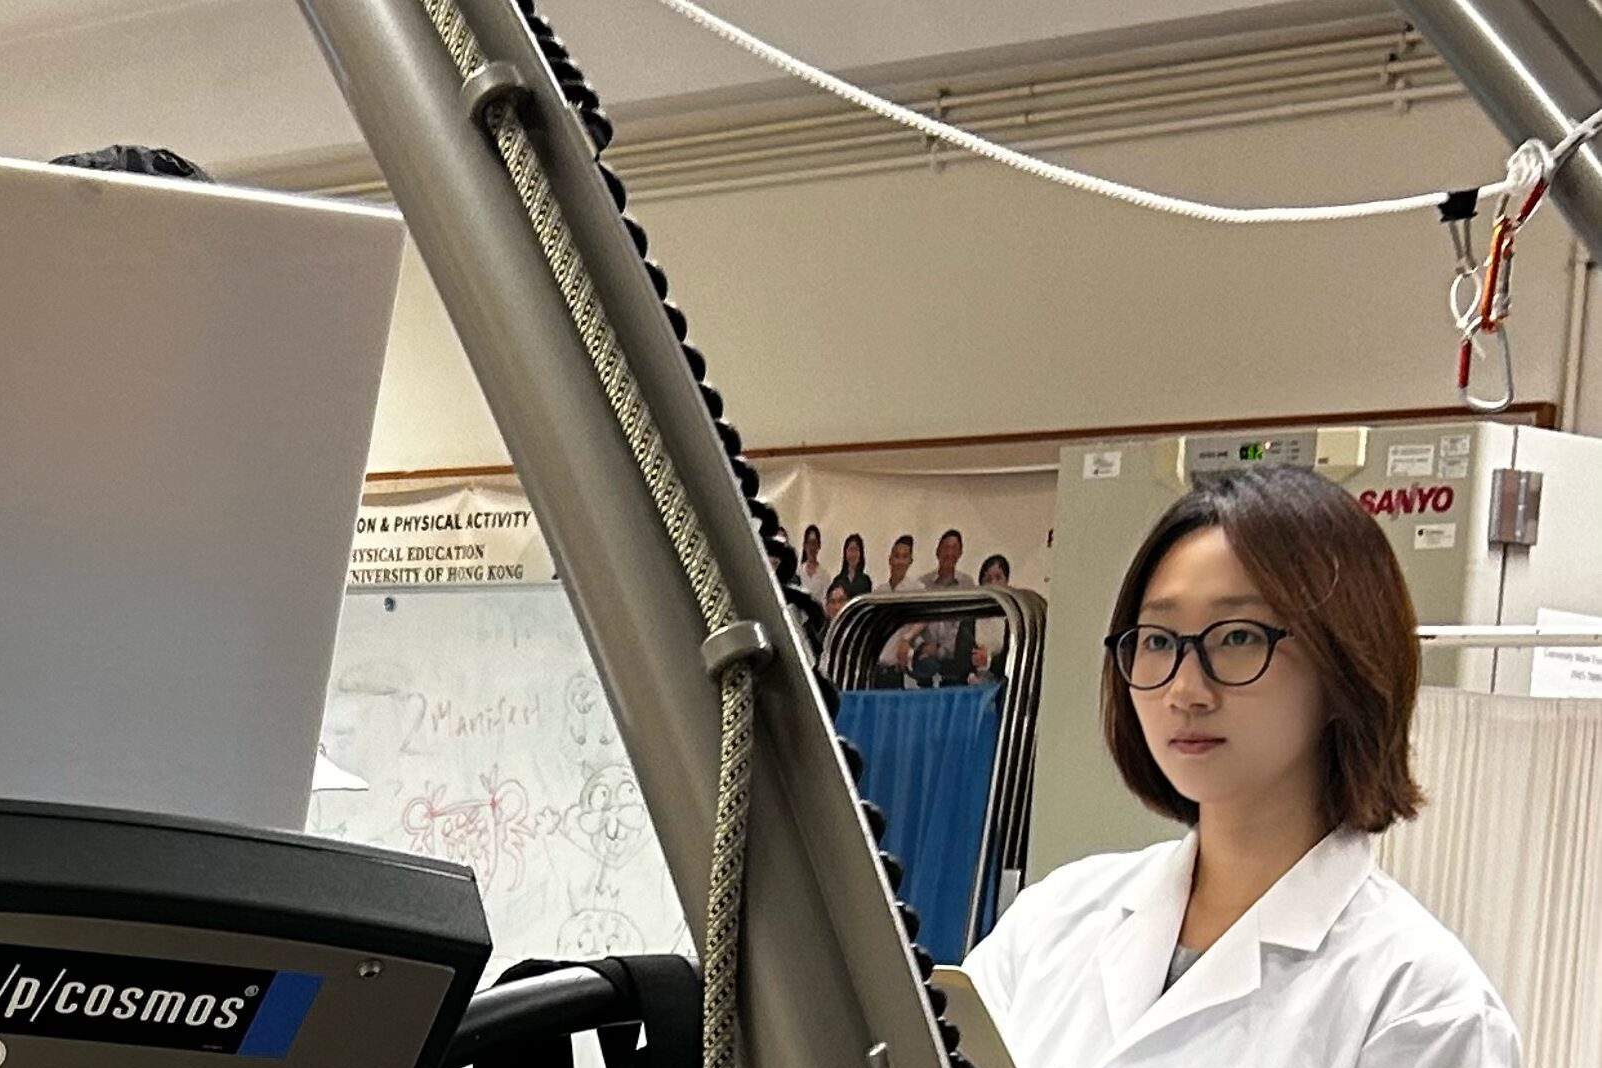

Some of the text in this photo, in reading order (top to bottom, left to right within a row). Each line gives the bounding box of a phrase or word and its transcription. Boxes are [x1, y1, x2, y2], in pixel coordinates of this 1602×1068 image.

[1359, 486, 1454, 515] SANYO
[355, 510, 532, 534] ON & PHYSICAL ACTIVITY
[406, 544, 486, 562] EDUCATION
[349, 564, 524, 584] NIVERSITY OF HONG KONG
